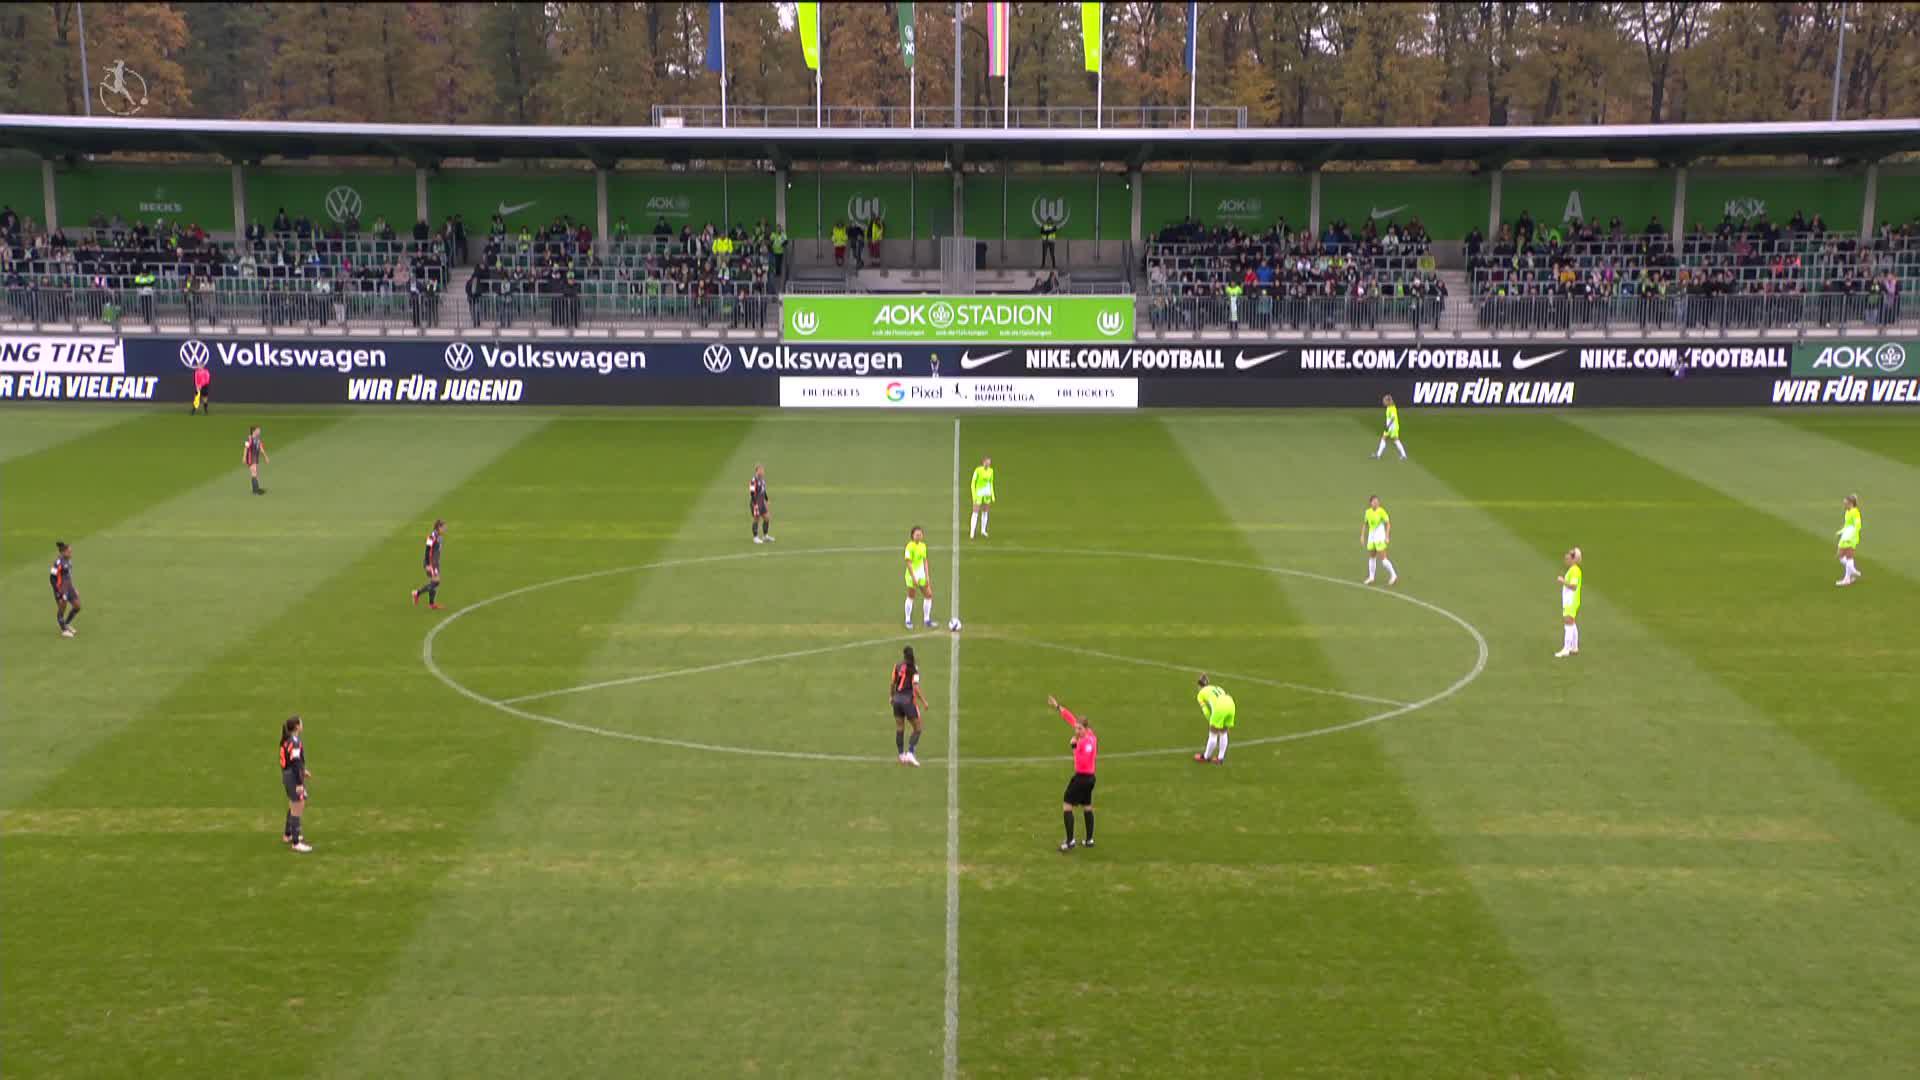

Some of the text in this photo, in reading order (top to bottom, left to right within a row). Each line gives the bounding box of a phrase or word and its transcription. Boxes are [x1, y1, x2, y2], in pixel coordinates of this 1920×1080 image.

[647, 197, 674, 209] AOK
[1217, 199, 1245, 211] AOK
[873, 304, 1052, 326] AOK STADION
[0, 343, 116, 364] NG TIRE
[216, 343, 386, 372] Volkswagen
[480, 344, 646, 374] Volkswagen
[738, 346, 903, 375] Volkswagen
[1026, 348, 1225, 369] NIKE.COM/FOOTBALL
[1300, 348, 1502, 369] NIKE.COM/FOOTBALL
[1812, 346, 1873, 368] AOK
[17, 370, 62, 397] FÜR
[66, 376, 158, 398] VIELFALT
[348, 374, 523, 401] WIR FÜR JUGEND
[911, 385, 943, 399] Pixel
[974, 383, 1013, 392] FRAUEN
[1413, 377, 1575, 403] WIR FÜR KLIMA
[1772, 375, 1920, 402] WIR FÜR VIEL
[974, 393, 1035, 401] BUNDESLIGA
